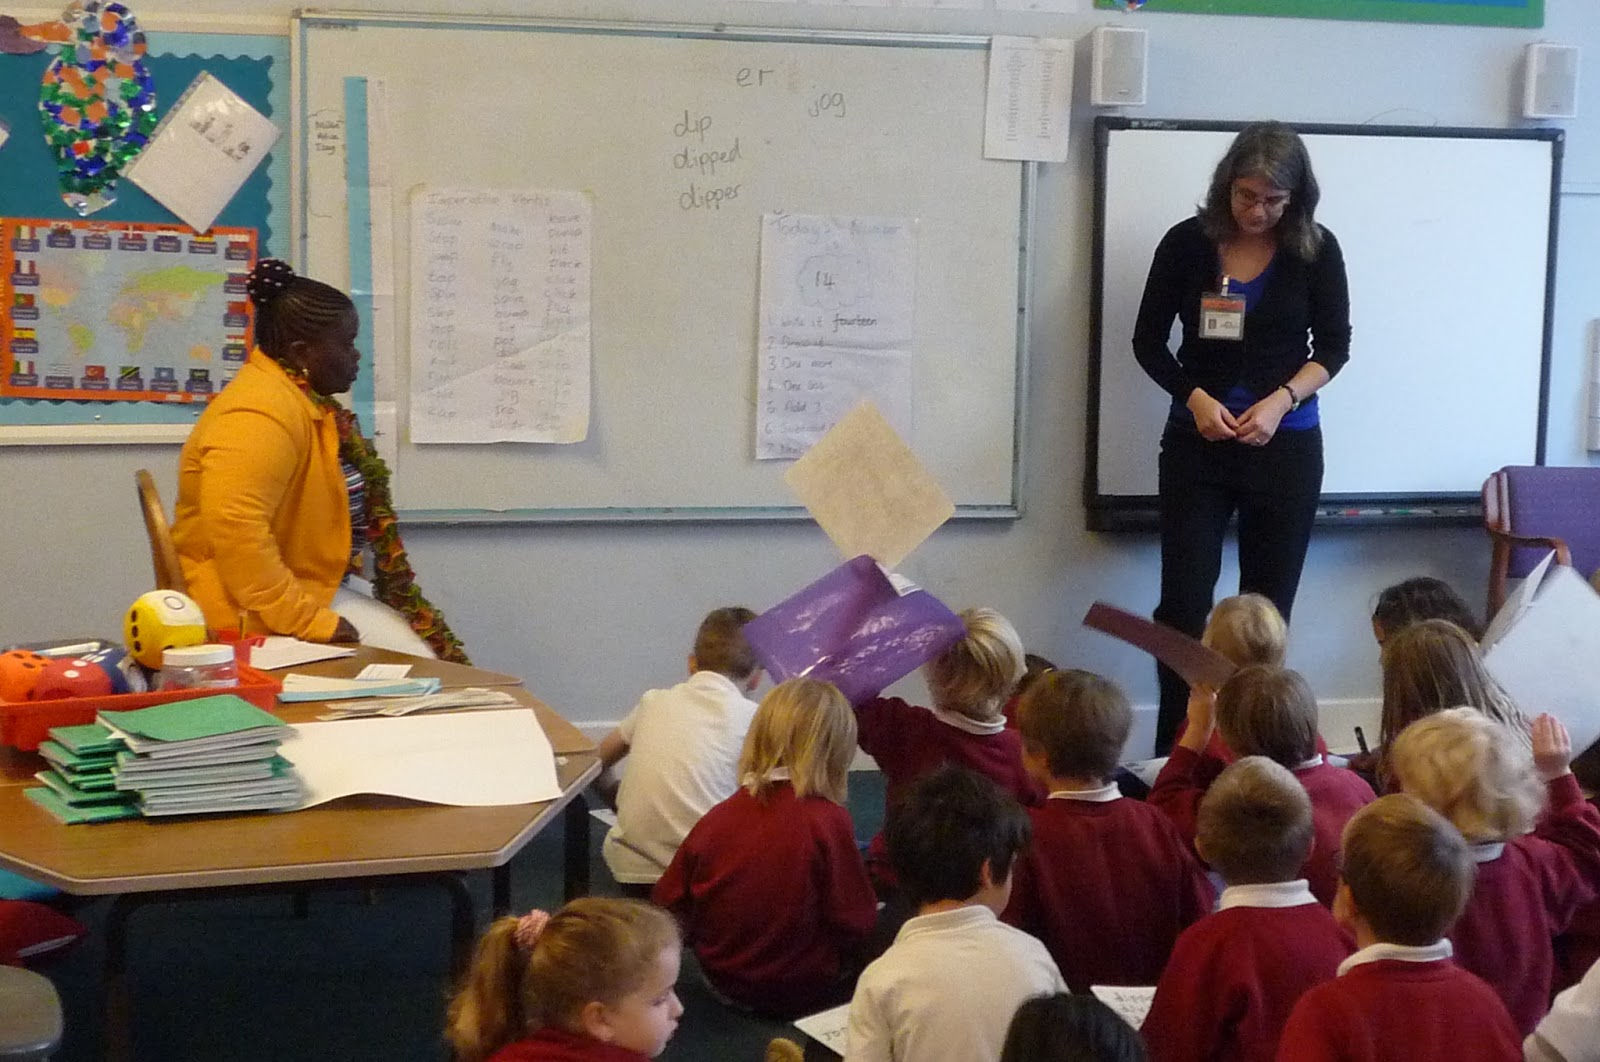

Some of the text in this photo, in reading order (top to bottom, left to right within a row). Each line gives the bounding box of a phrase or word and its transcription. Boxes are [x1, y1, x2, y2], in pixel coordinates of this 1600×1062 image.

[736, 67, 775, 87] er
[808, 85, 846, 118] jog
[673, 109, 712, 142] dip
[673, 137, 742, 176] dipped
[679, 183, 742, 211] dipper
[815, 270, 836, 291] 14
[768, 355, 777, 371] 3
